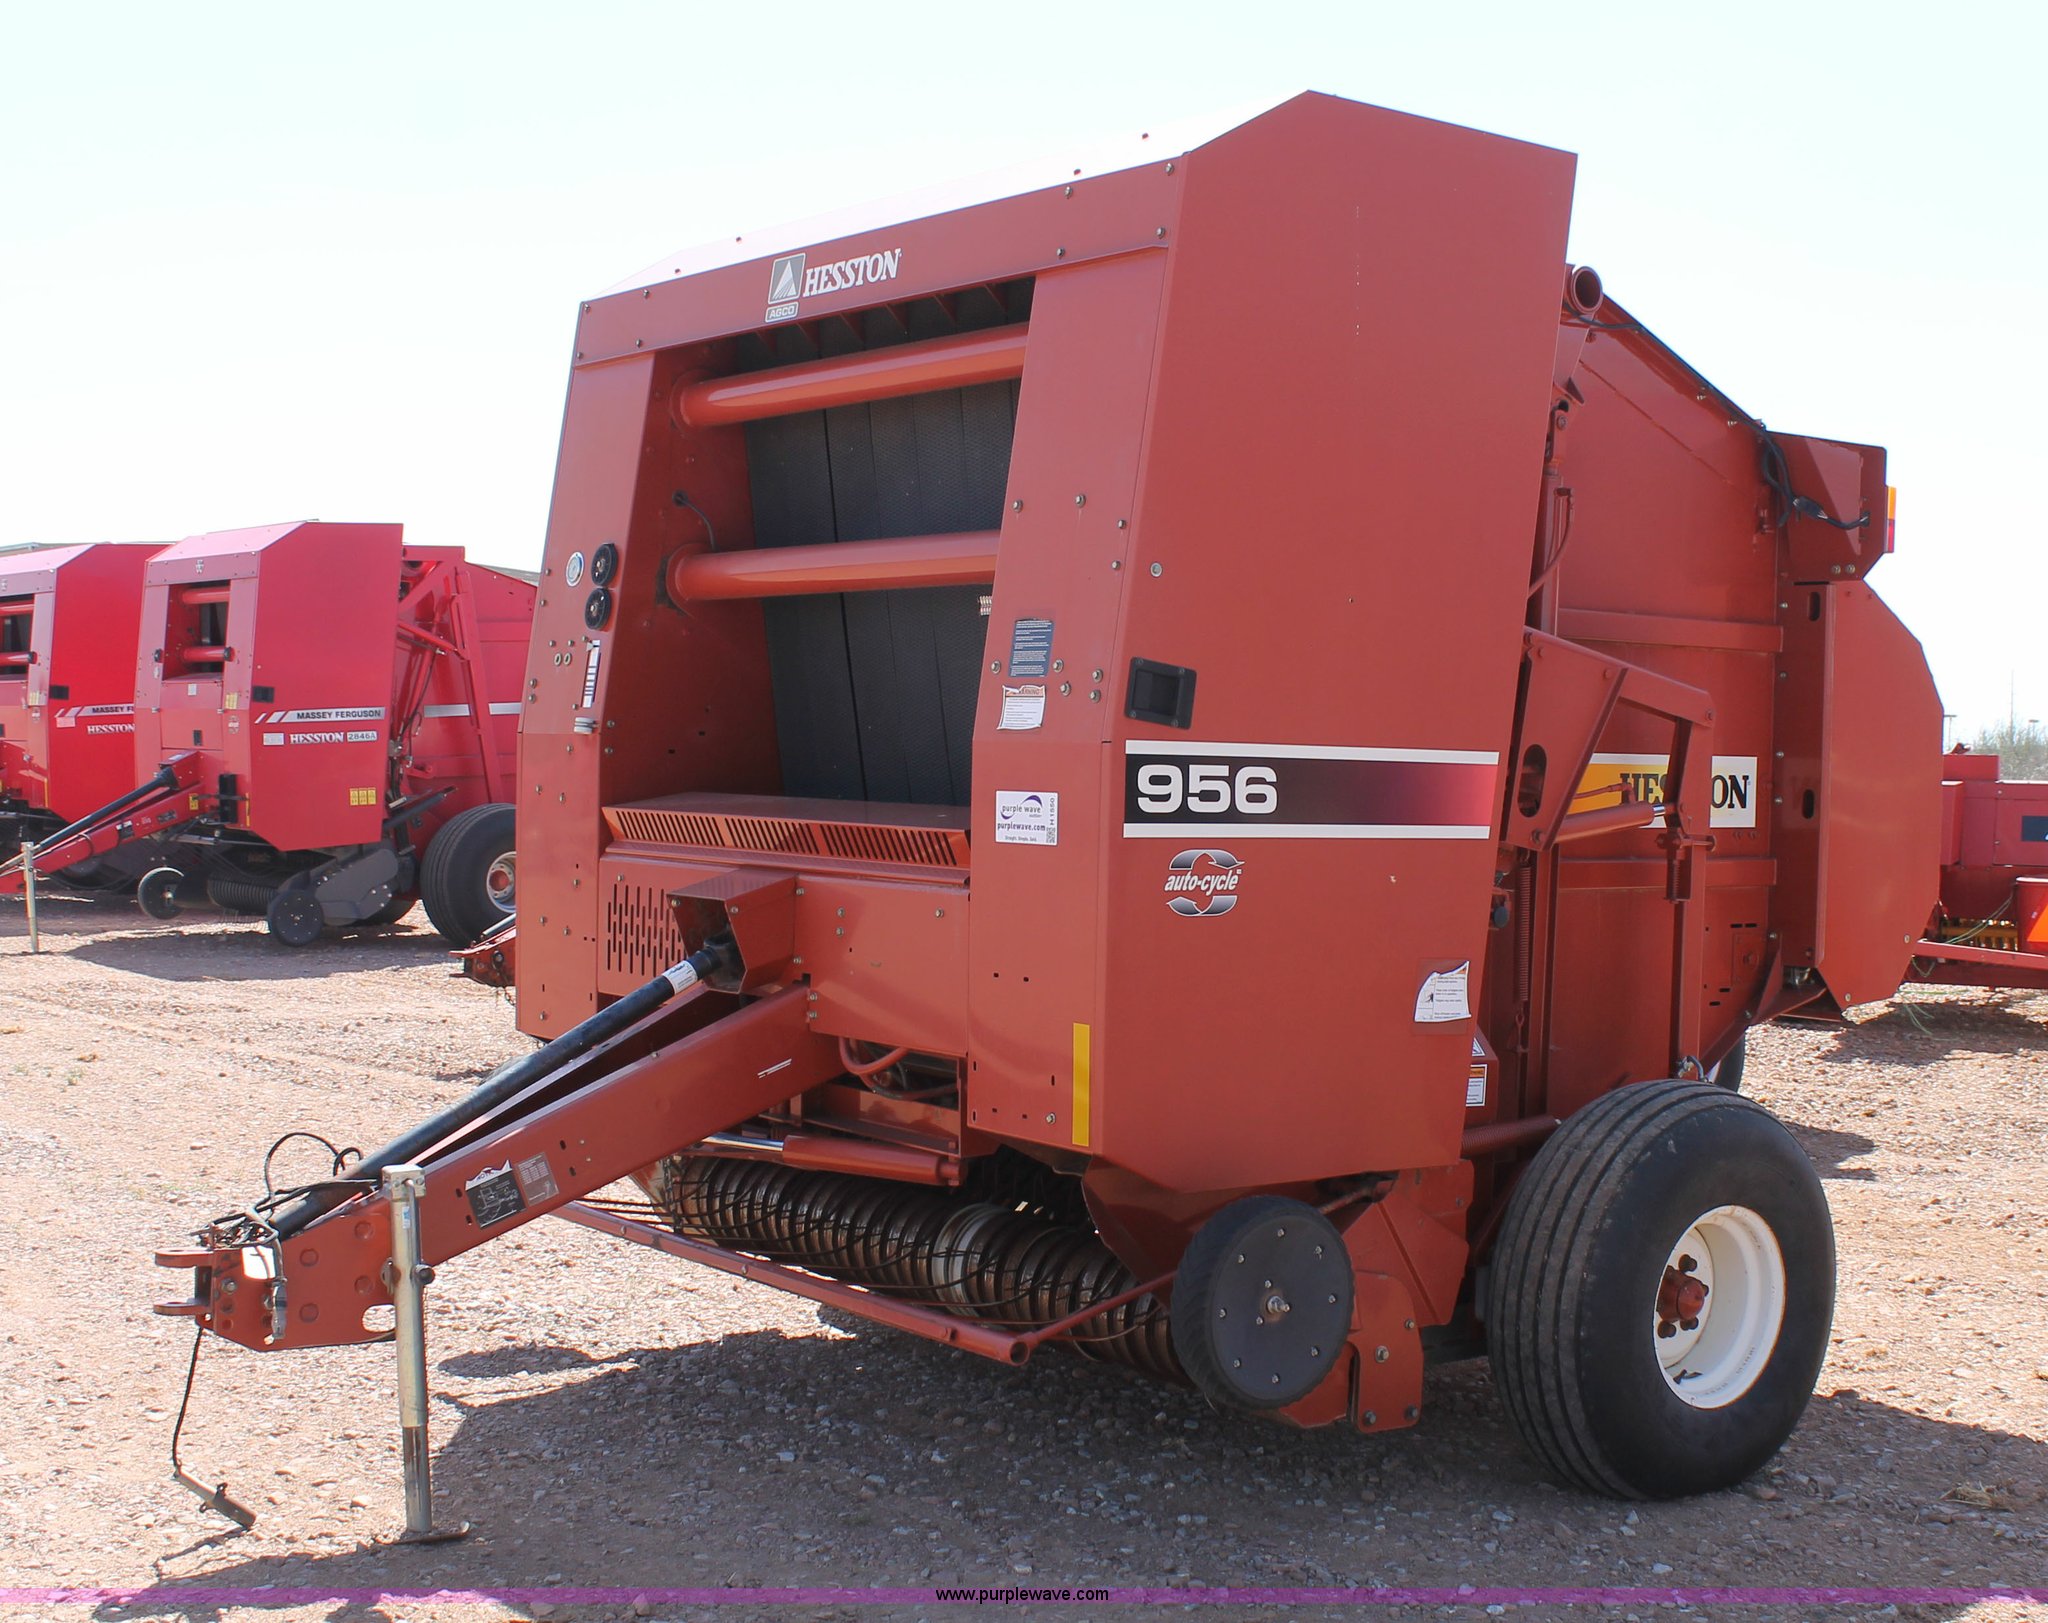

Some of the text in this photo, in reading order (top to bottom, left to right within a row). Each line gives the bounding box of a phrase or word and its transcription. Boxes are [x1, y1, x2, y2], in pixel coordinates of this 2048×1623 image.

[803, 248, 901, 297] HESSTON
[769, 305, 795, 319] AGCO
[296, 710, 381, 719] MASSEY FERGUSON
[87, 723, 135, 734] HESSTON
[290, 732, 376, 744] HESSTON 2846A
[1137, 764, 1278, 814] 956
[1002, 804, 1022, 813] purple
[997, 822, 1046, 831] purplewave.com
[1164, 869, 1239, 896] auto-cycle
